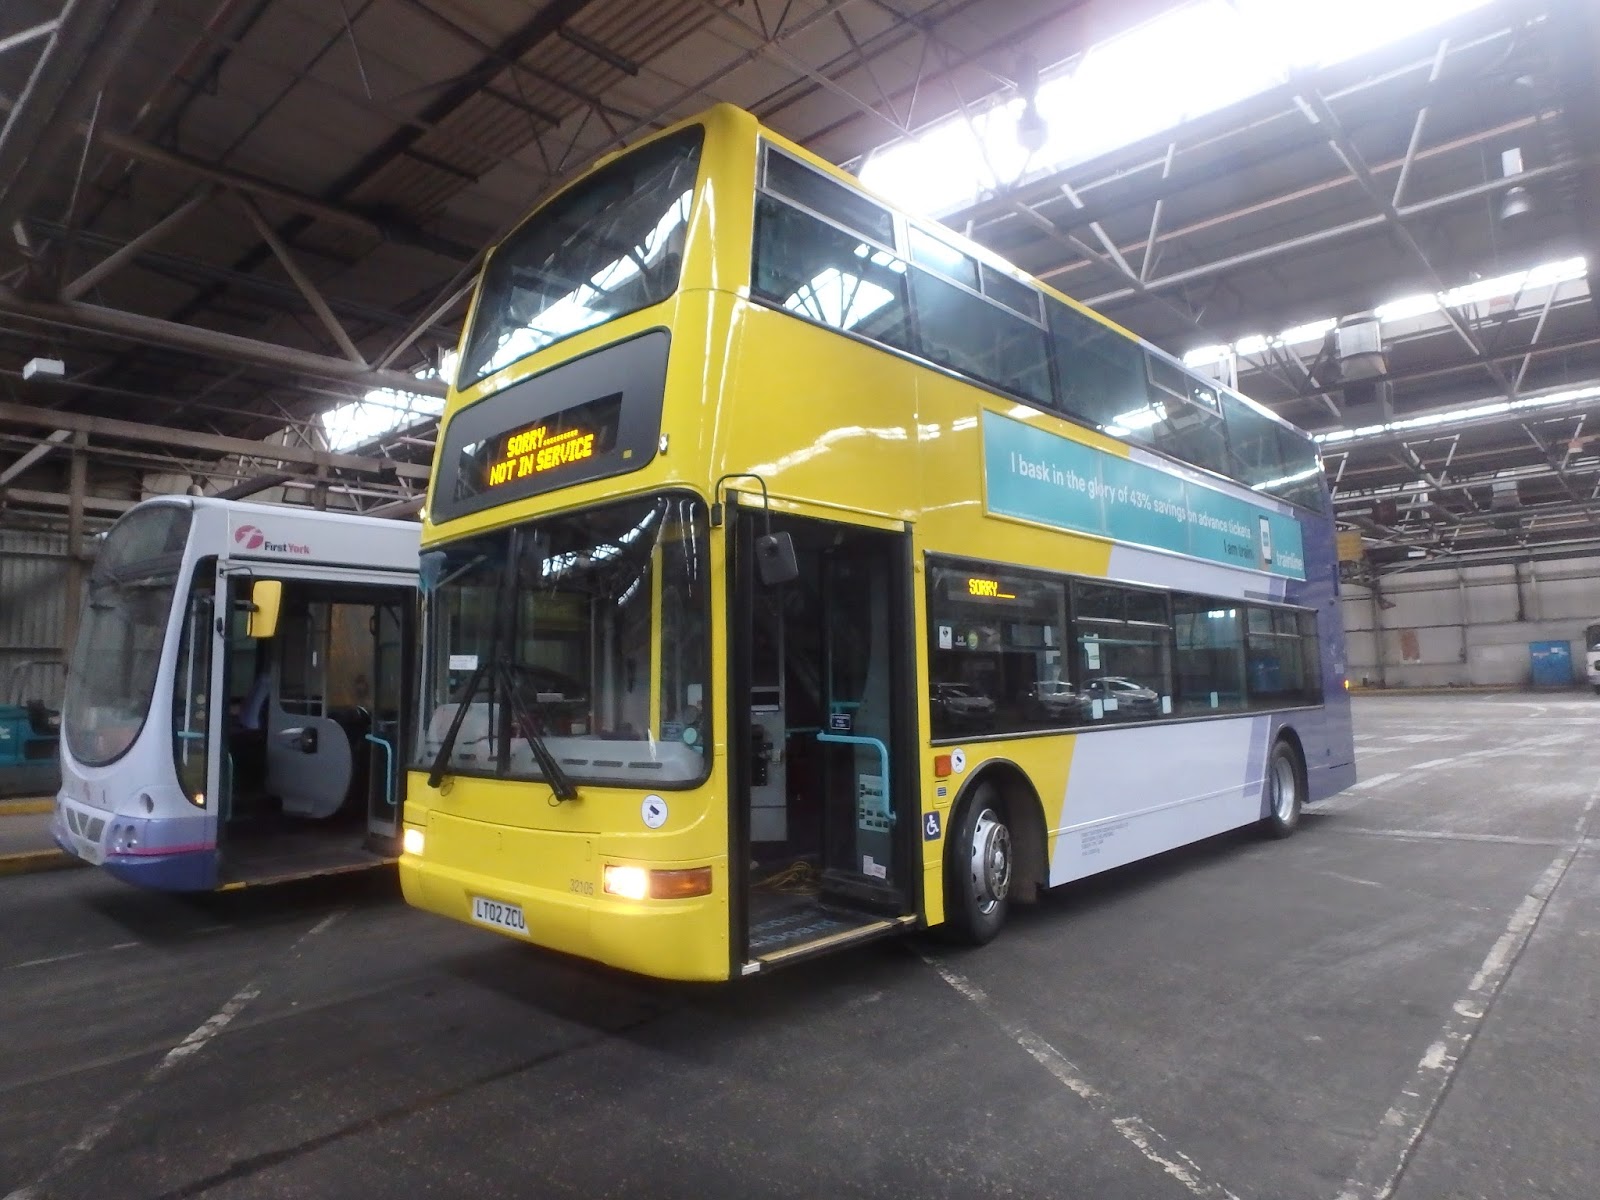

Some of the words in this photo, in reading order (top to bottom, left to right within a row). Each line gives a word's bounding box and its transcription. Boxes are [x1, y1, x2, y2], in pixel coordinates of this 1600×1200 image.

[489, 459, 517, 487] NOT
[517, 455, 533, 478] IN
[536, 433, 594, 472] SERVICE
[1011, 451, 1016, 473] I
[1018, 453, 1050, 483] bask
[1052, 463, 1064, 486] in
[1066, 469, 1086, 492] the
[1087, 476, 1116, 505] glory
[1117, 485, 1128, 503] of
[1130, 489, 1152, 511] 43%
[1153, 499, 1186, 523] savings
[1187, 510, 1198, 523] on
[1198, 511, 1228, 533] advance
[1228, 519, 1251, 539] tickets
[264, 541, 287, 552] First
[288, 543, 310, 555] York
[1223, 539, 1227, 554] I
[1227, 544, 1238, 556] am
[569, 878, 594, 896] 32105
[476, 901, 502, 923] LT02
[505, 907, 525, 929] ZCU
